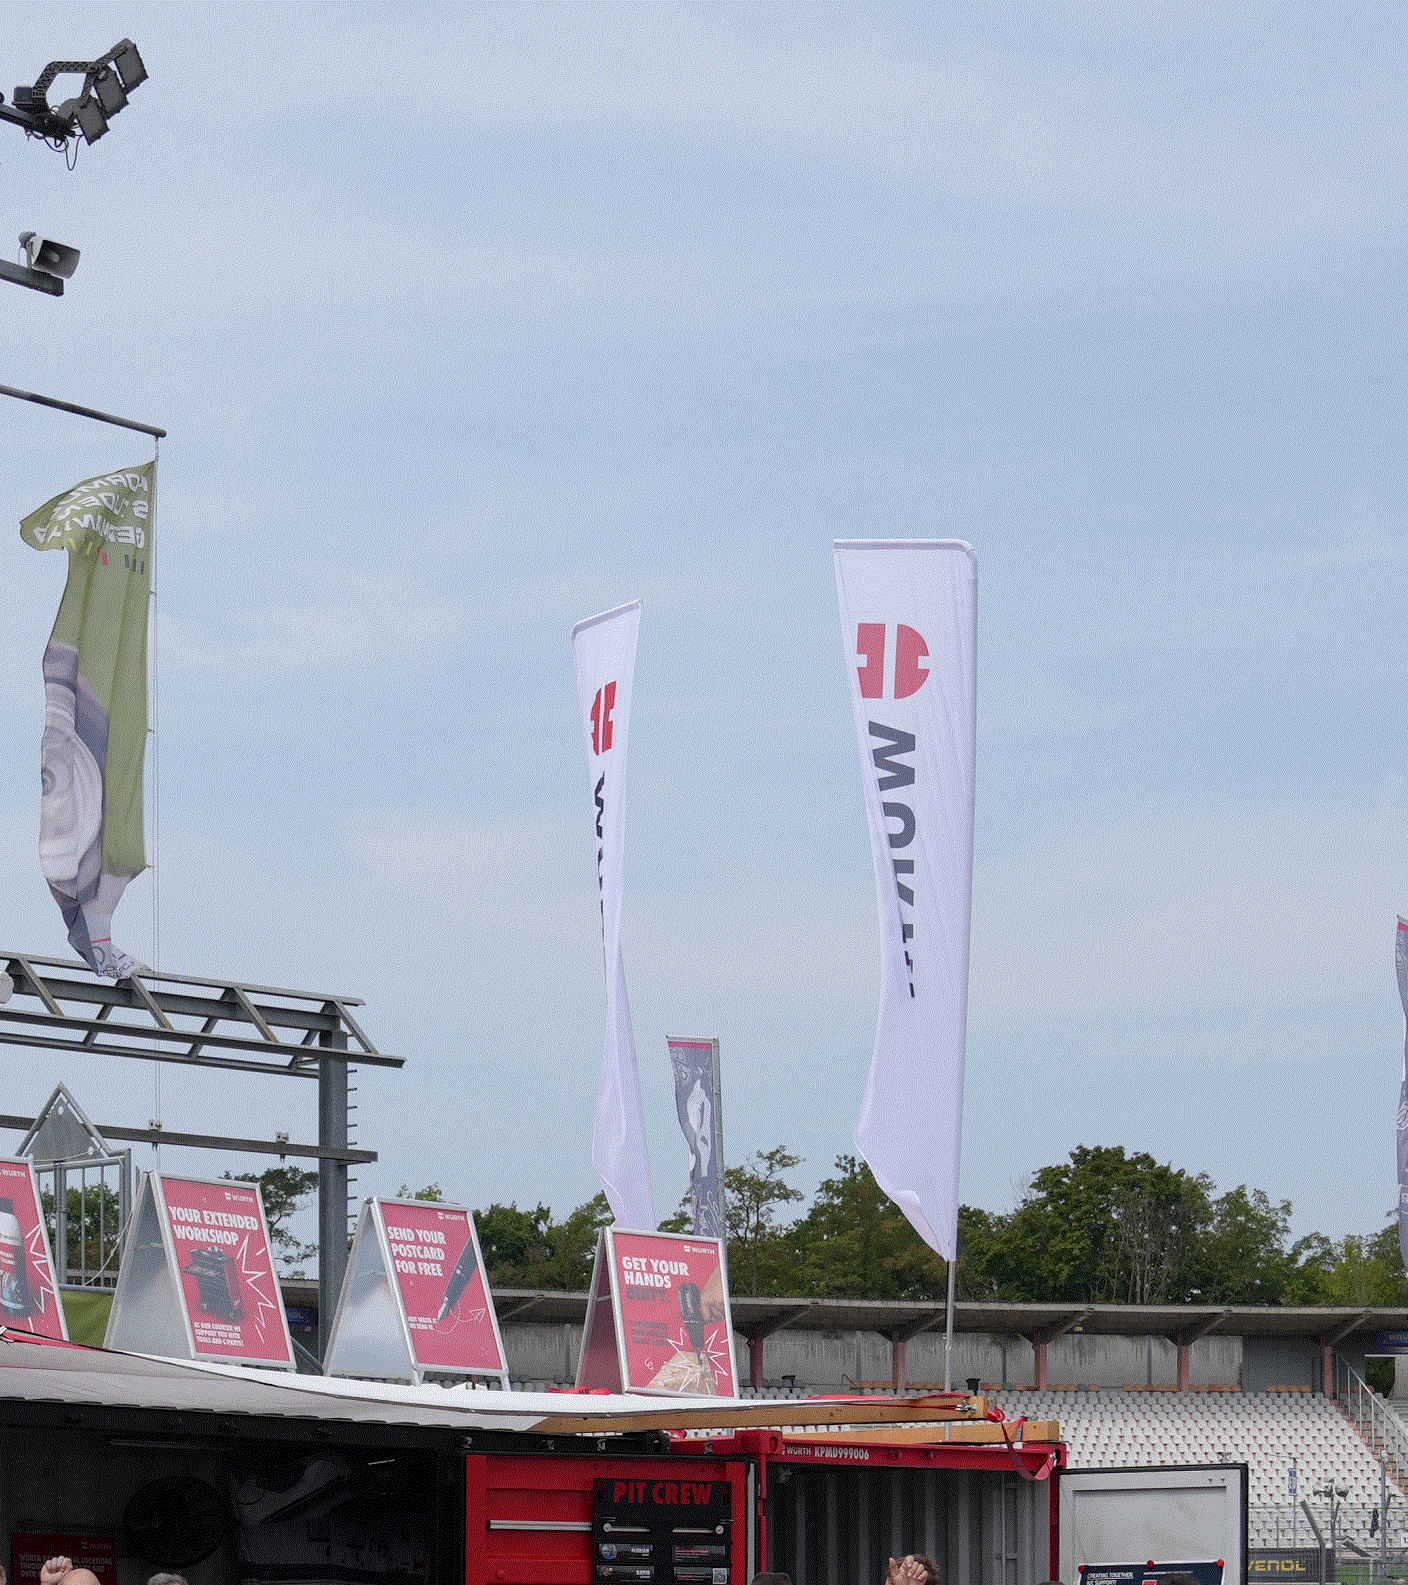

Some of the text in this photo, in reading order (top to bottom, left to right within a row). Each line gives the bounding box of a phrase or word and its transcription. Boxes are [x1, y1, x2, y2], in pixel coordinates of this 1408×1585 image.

[168, 1206, 259, 1232] YOUR EXTENDED
[173, 1225, 239, 1245] WORKSHOP
[387, 1226, 447, 1245] SEND YOUR
[390, 1243, 446, 1262] POSTCARD
[394, 1260, 444, 1277] FOR FREE
[622, 1256, 690, 1277] GET YOUR
[623, 1270, 672, 1289] HANDS
[814, 1448, 870, 1461] KPMD999006
[614, 1481, 713, 1506] PIT CREW
[1248, 1558, 1307, 1574] VENOL
